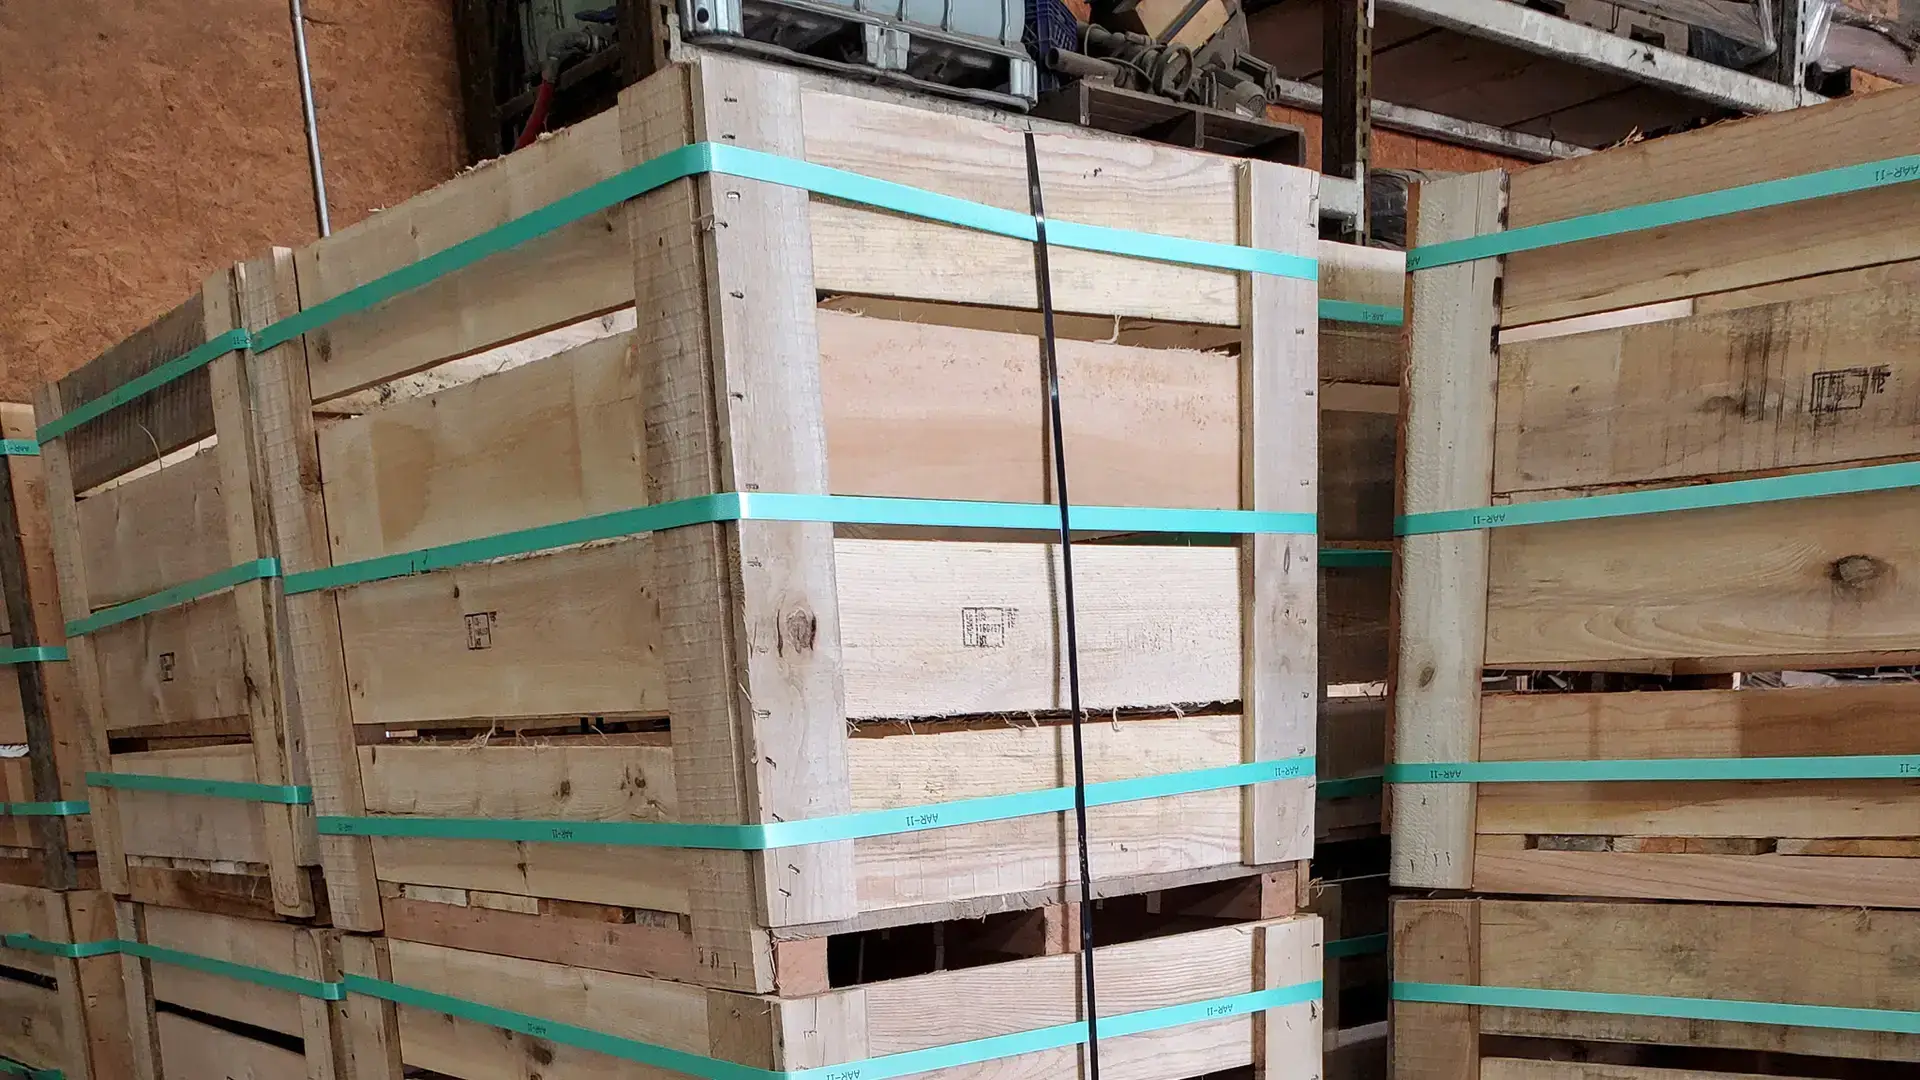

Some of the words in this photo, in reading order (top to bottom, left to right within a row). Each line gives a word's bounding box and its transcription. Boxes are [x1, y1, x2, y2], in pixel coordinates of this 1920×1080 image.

[1875, 164, 1920, 182] AAR-11
[1362, 310, 1385, 321] AAR-11
[1473, 513, 1506, 525] AAR-11
[1275, 765, 1300, 777] AAR-11
[1430, 770, 1462, 780] AAR-11
[906, 812, 939, 827] AAR-11
[1207, 1004, 1234, 1017] AAR-11
